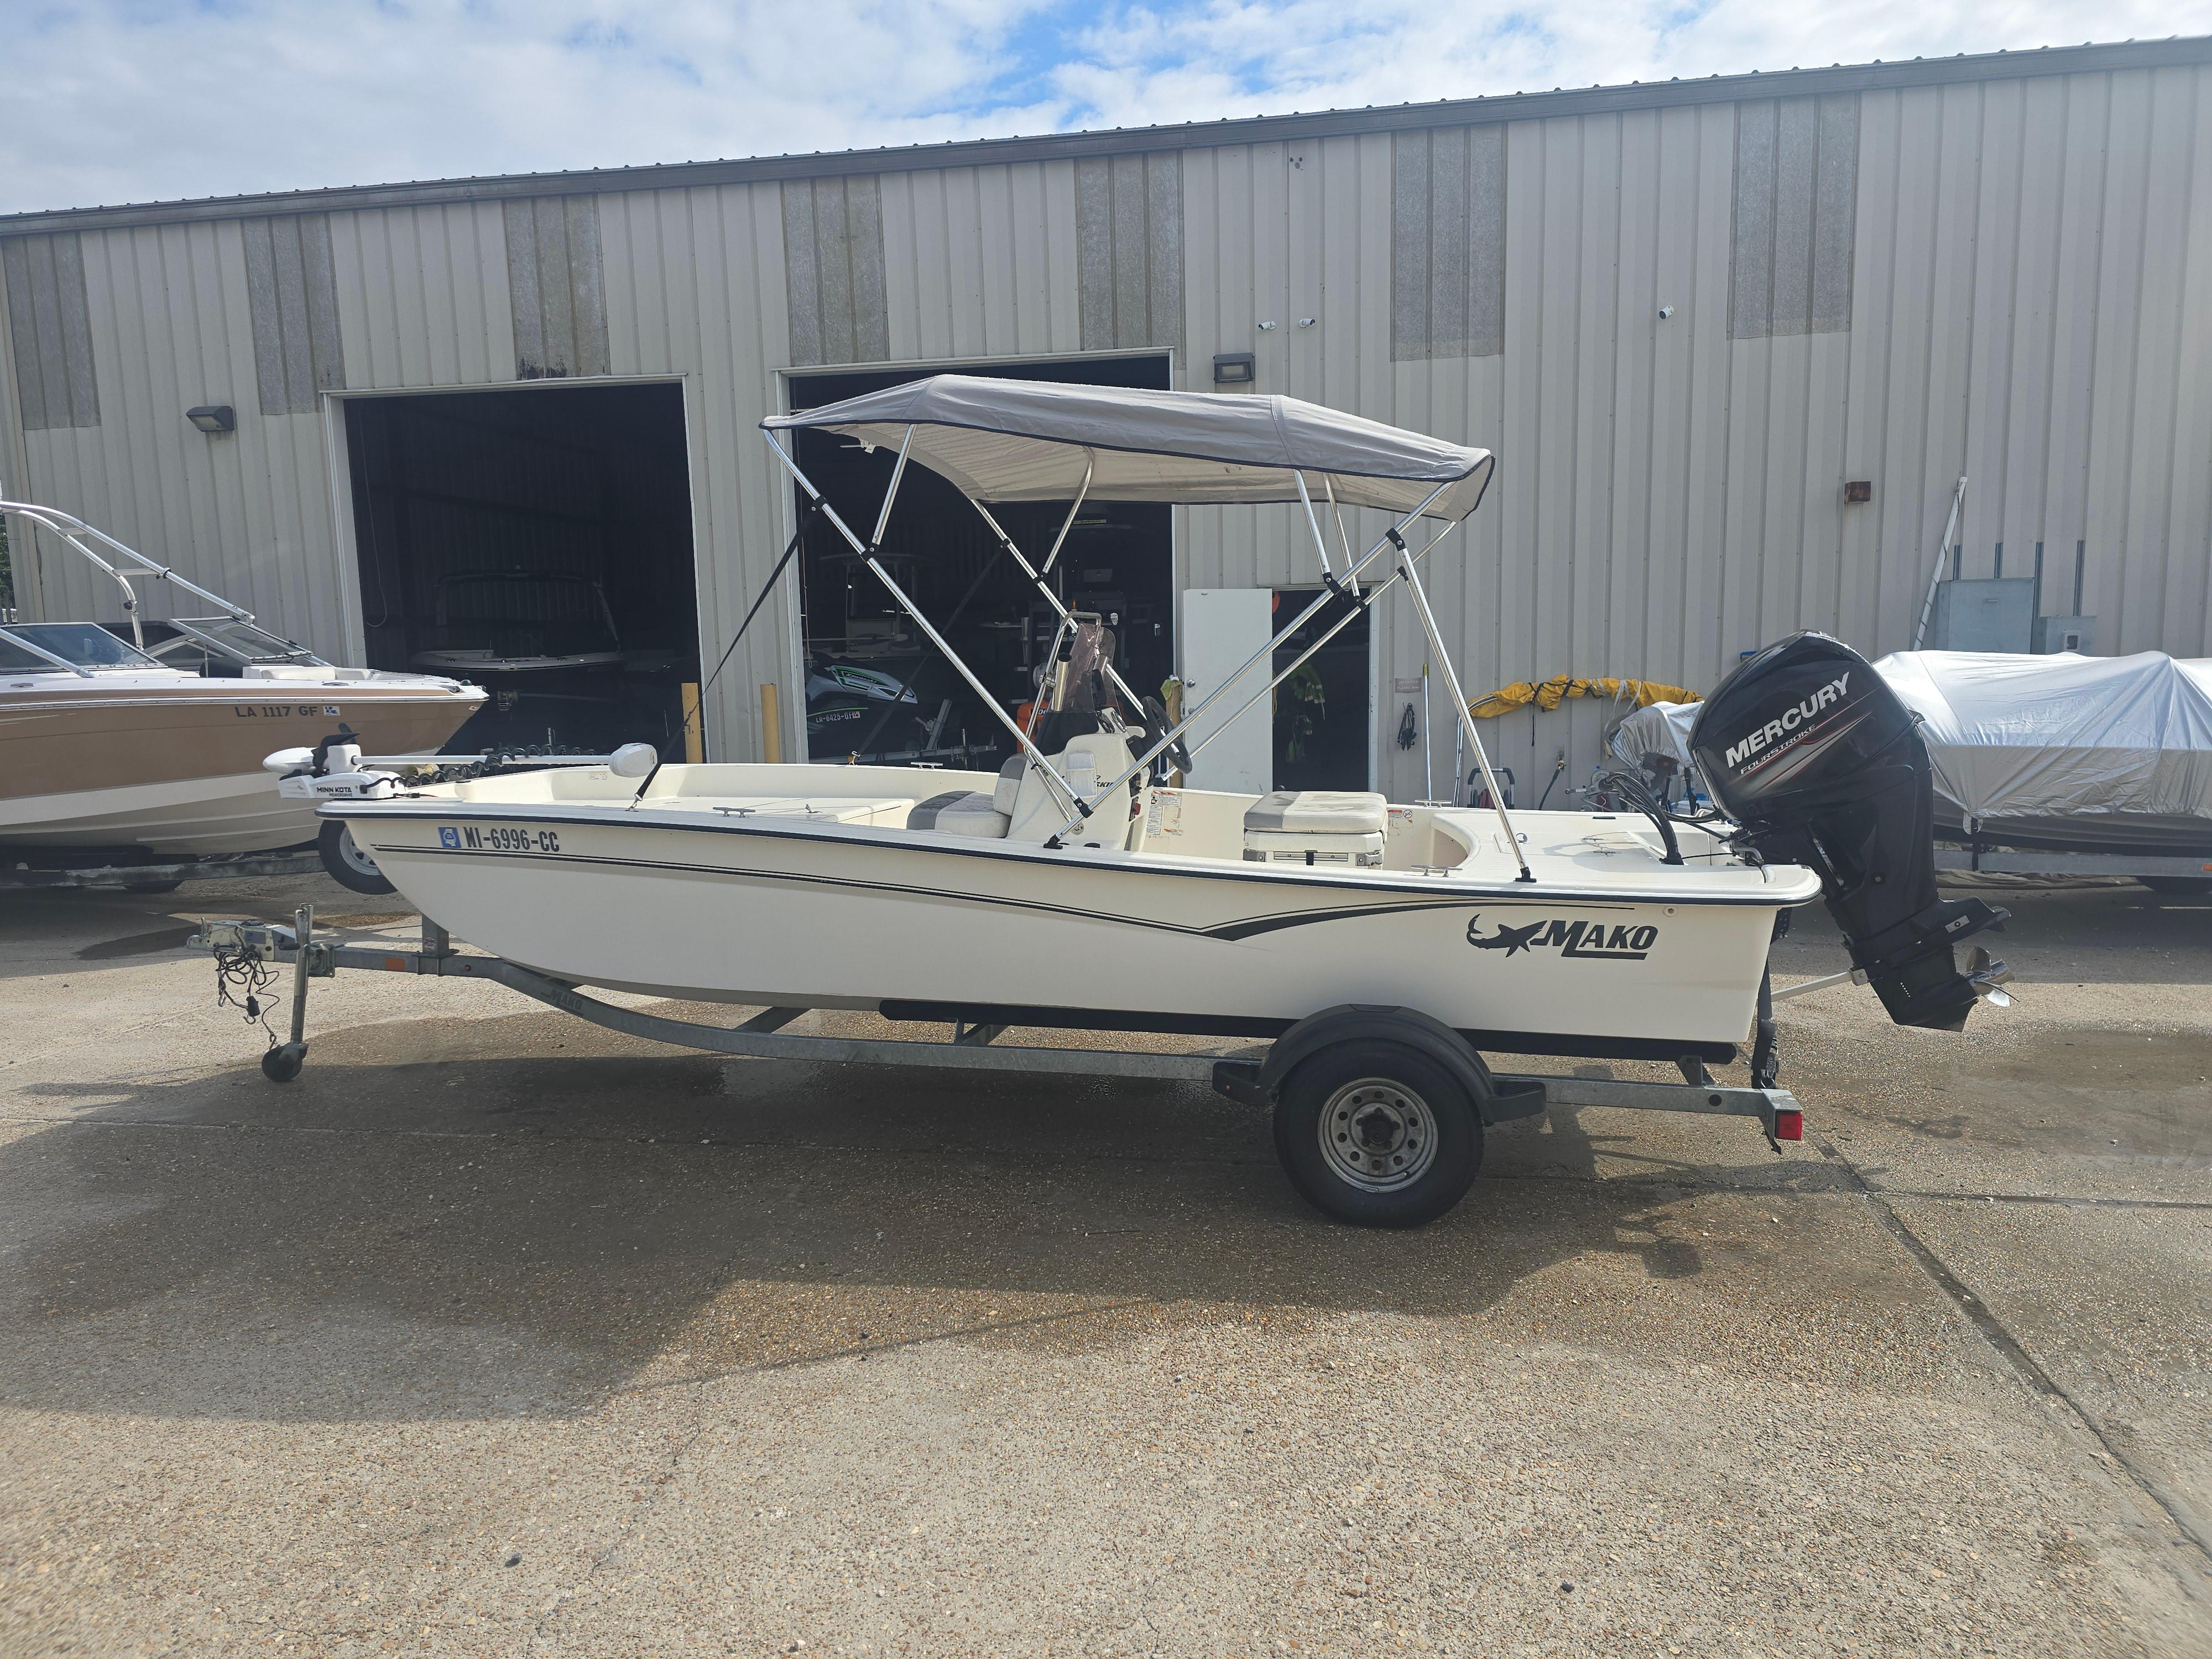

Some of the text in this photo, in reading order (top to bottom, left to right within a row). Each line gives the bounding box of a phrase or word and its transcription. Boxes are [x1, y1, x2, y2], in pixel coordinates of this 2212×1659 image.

[234, 706, 257, 717] LA
[262, 706, 291, 717] 1117
[298, 706, 317, 717] GF
[1725, 671, 1849, 768] MERCURY
[1740, 723, 1816, 775] FOURSTROKE
[463, 826, 560, 852] MI-6996-CC
[1530, 920, 1658, 960] MAKO
[540, 988, 584, 1017] MAKO
